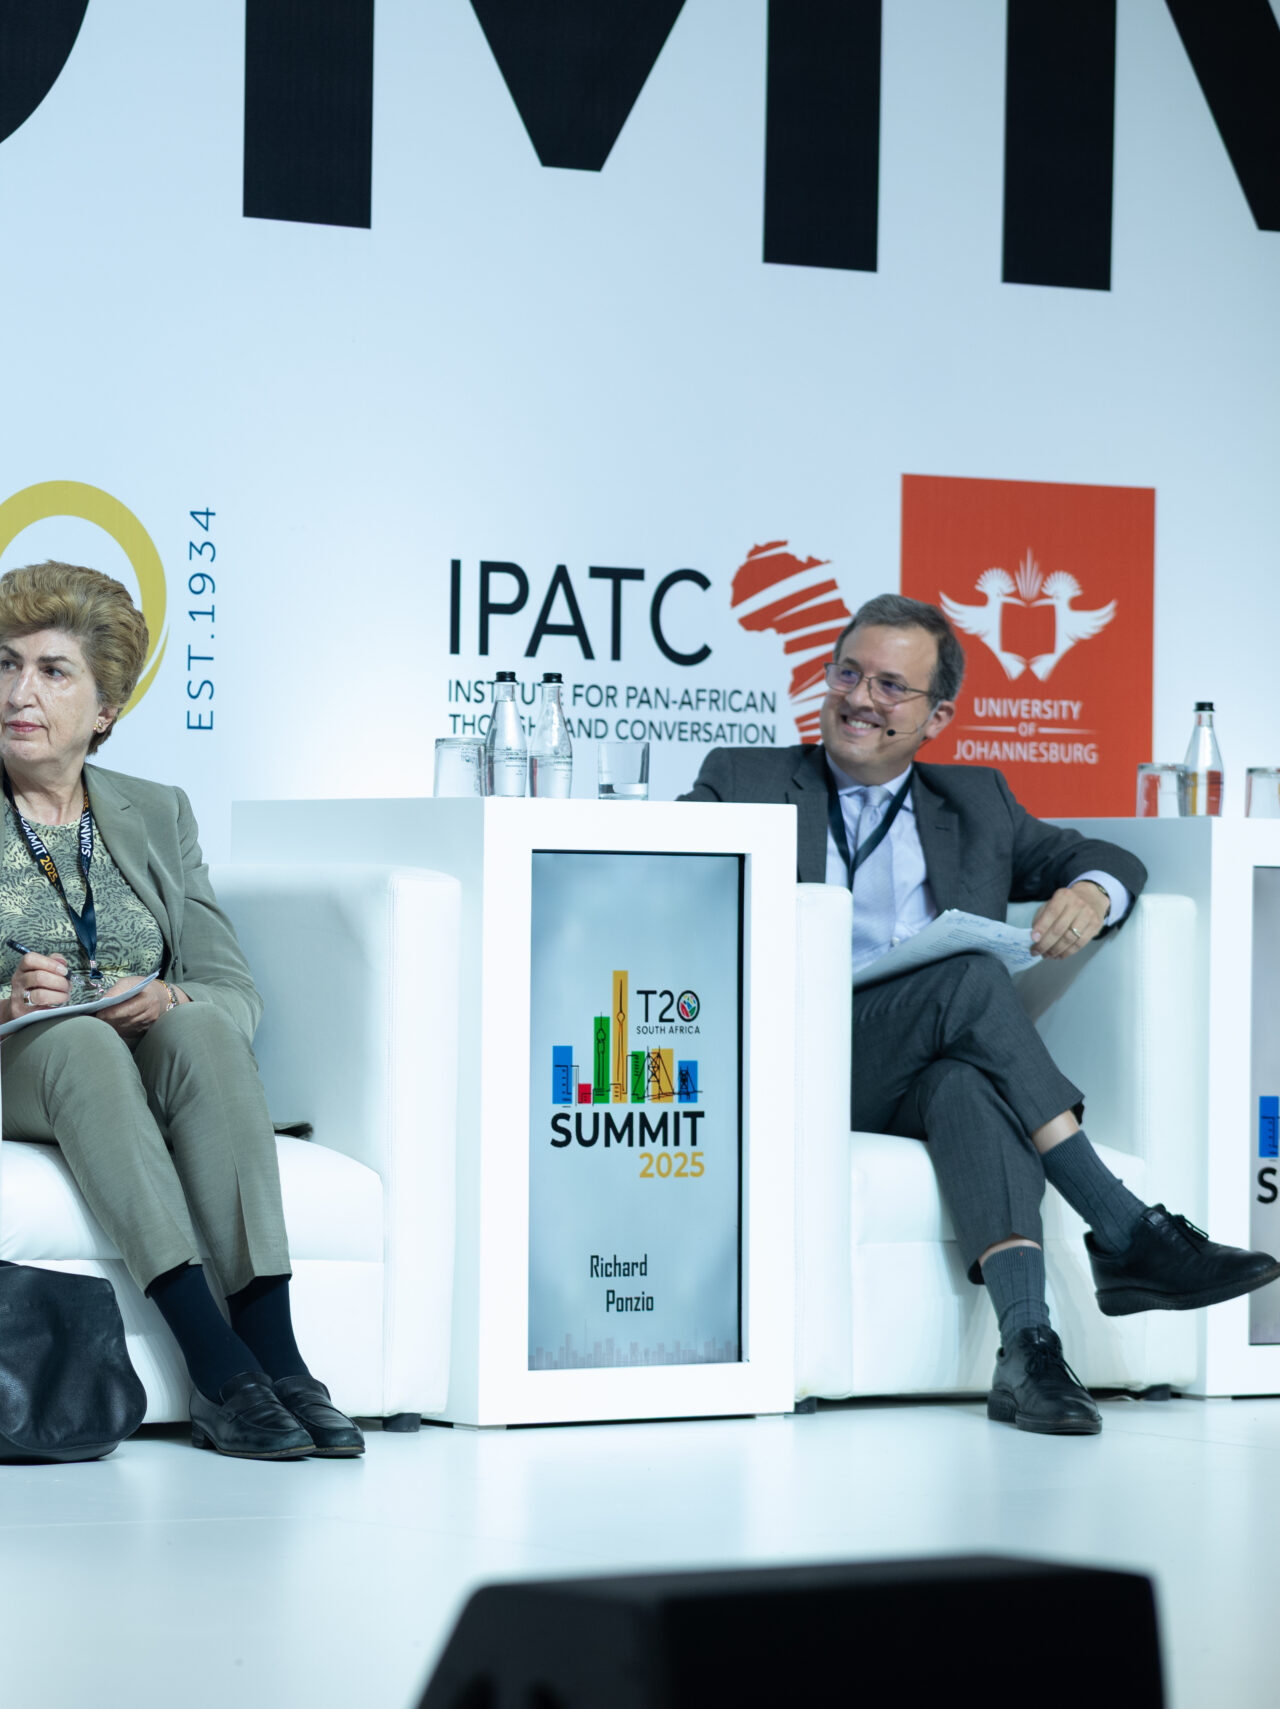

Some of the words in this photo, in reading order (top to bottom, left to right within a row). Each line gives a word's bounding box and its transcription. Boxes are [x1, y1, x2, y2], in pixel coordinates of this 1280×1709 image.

[186, 507, 216, 731] EST.1934
[448, 558, 713, 667] IPATC
[572, 684, 618, 708] FOR
[625, 686, 777, 714] PAN-AFRICAN
[973, 697, 1083, 721] UNIVERSITY
[615, 719, 777, 744] CONVERSATION
[1018, 722, 1037, 738] OF
[952, 739, 1099, 764] JOHANNESBURG
[636, 989, 701, 1023] T20
[636, 1025, 666, 1035] SOUTH
[668, 1025, 701, 1035] AFRICA
[550, 1110, 706, 1149] SUMMIT
[638, 1151, 705, 1178] 2025
[590, 1253, 648, 1279] Richard
[605, 1289, 655, 1313] Ponzio
